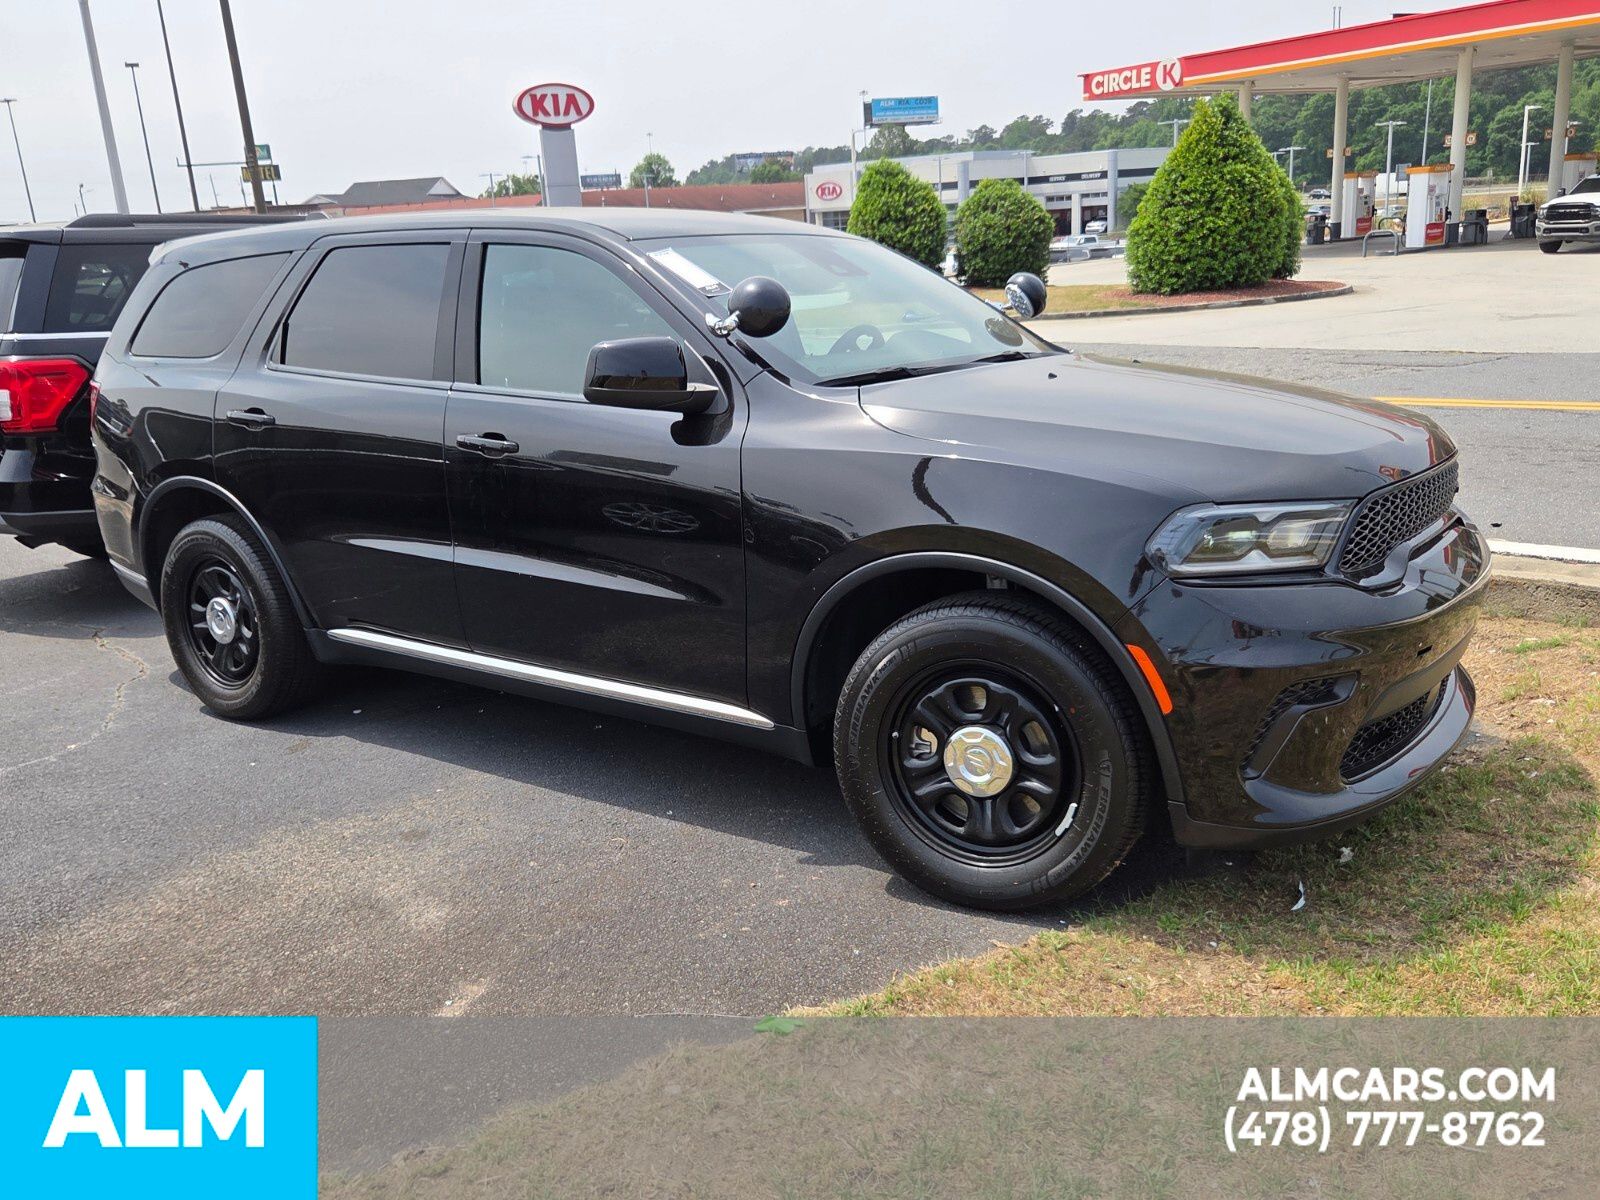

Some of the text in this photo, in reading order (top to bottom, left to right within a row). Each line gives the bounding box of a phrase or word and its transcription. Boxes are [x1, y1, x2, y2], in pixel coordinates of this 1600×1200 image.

[1091, 62, 1180, 95] CIRCLE K
[528, 93, 583, 117] KIA
[820, 186, 838, 198] KIA
